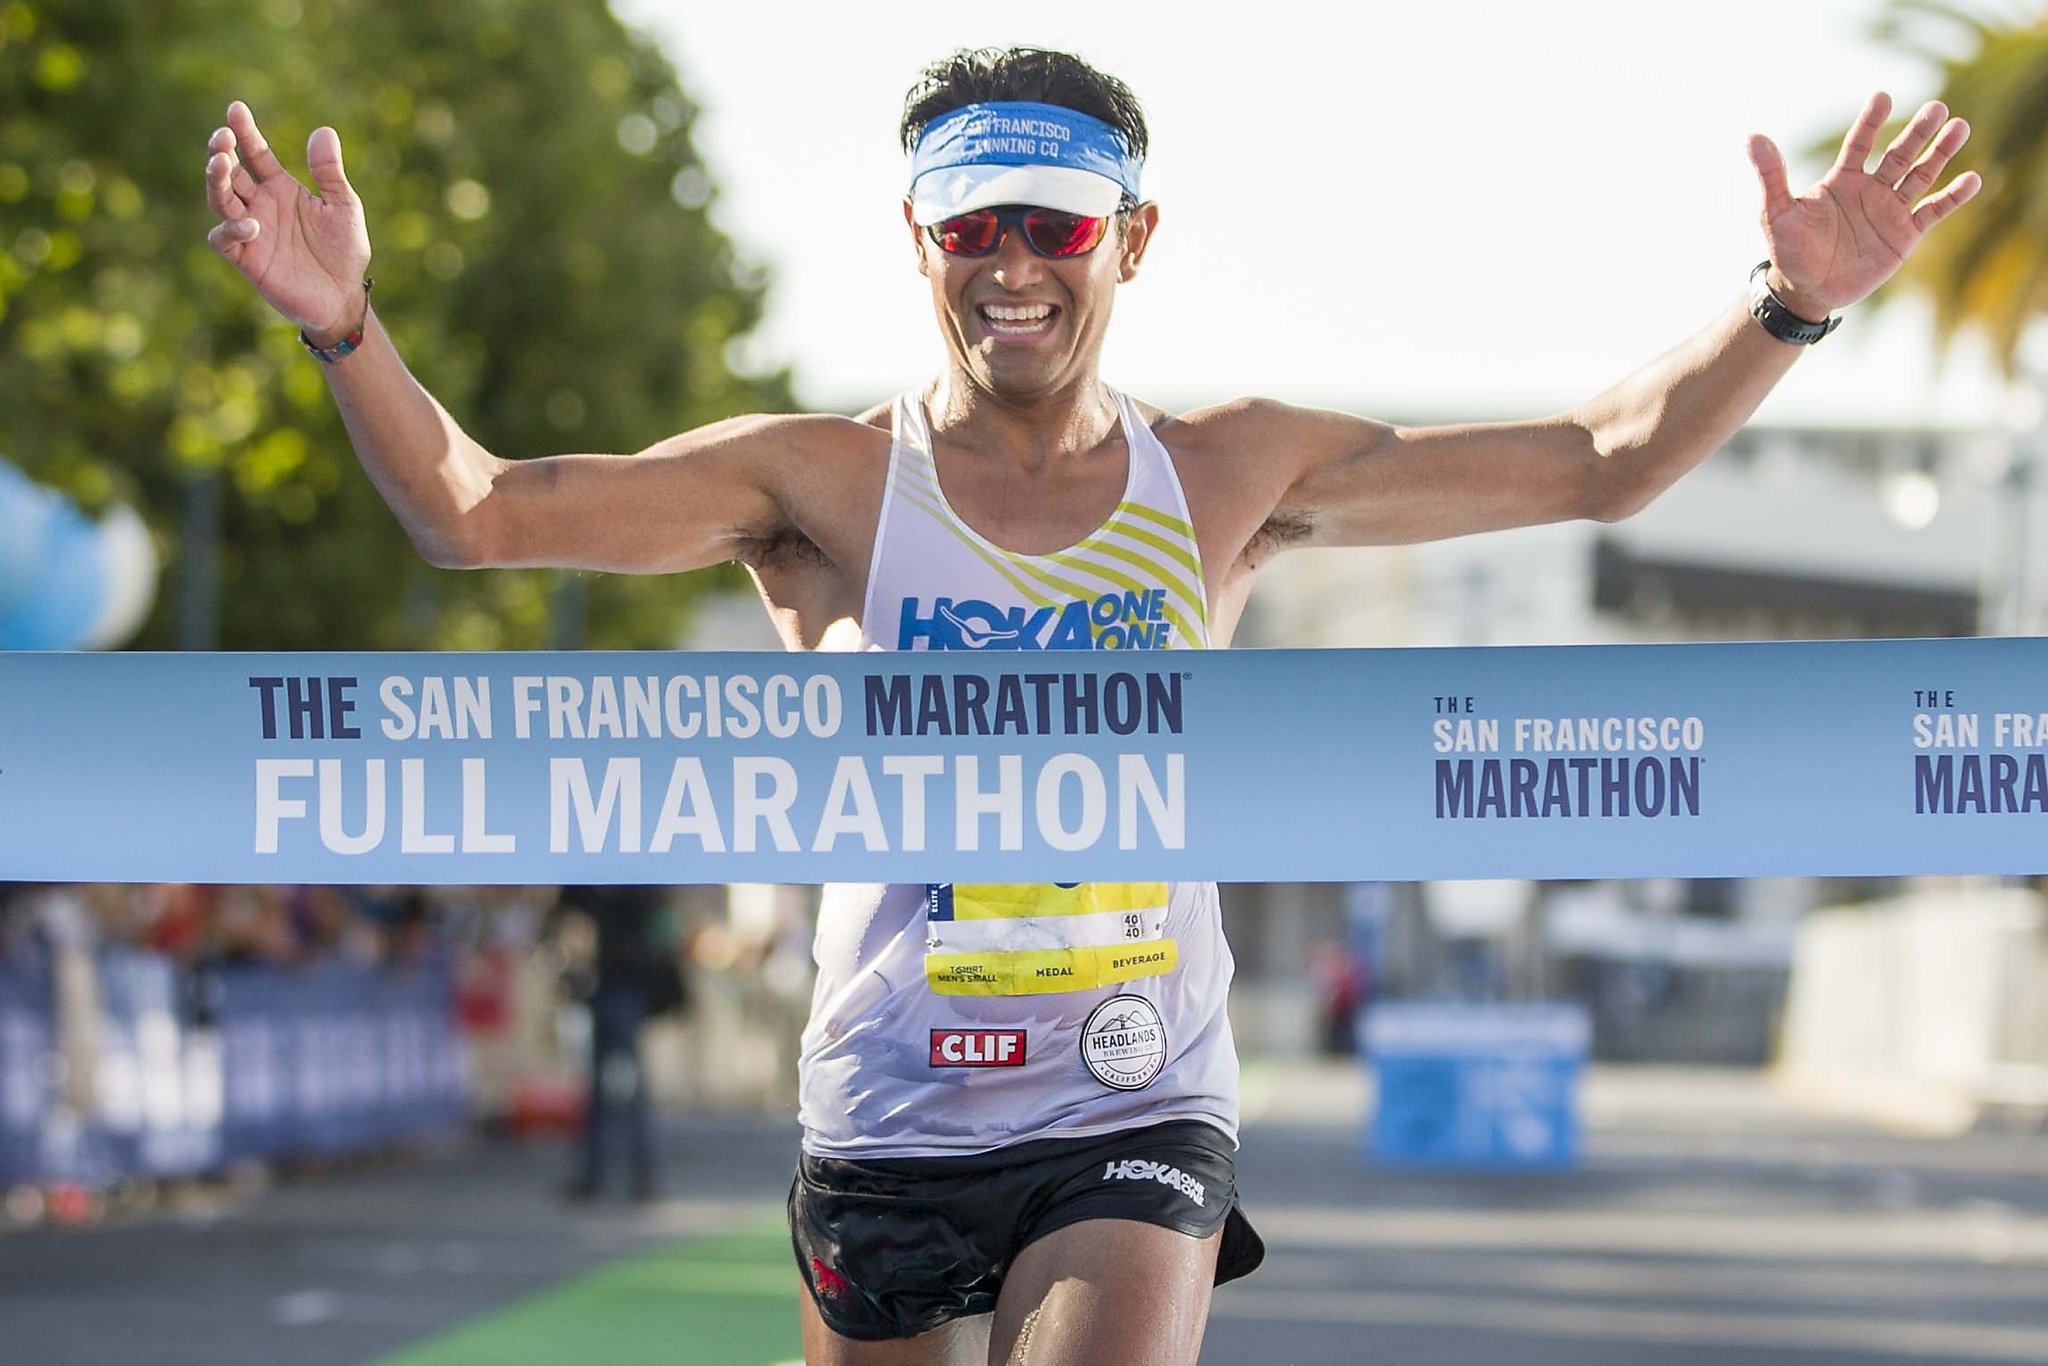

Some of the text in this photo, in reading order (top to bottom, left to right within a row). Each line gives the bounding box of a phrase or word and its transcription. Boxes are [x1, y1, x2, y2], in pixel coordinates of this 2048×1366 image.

[993, 118, 1070, 141] FRANCISCO
[898, 589, 1166, 650] HOKA ONE
[1092, 624, 1172, 650] ONE
[249, 672, 1184, 740] THE SAN FRANCISCO MARATHON
[1434, 697, 1474, 713] THE
[1914, 690, 1954, 708] THE
[1433, 716, 1705, 752] SAN FRANCISCO
[1913, 713, 1979, 748] SAN
[1435, 756, 1700, 818] MARATHON
[1915, 753, 2048, 814] MARA
[255, 753, 1186, 854] FULL MARATHON
[1124, 914, 1139, 925] 40
[1126, 927, 1140, 938] 40
[1036, 967, 1074, 977] MEDAL
[1112, 952, 1166, 969] BEVERAGE
[942, 1035, 1017, 1062] CLIF
[1093, 1029, 1156, 1049] HEADLANDS
[1104, 1063, 1155, 1083] CALIFORNIA
[1103, 1160, 1205, 1196] HOKA ONE
[1181, 1184, 1205, 1208] ONE
